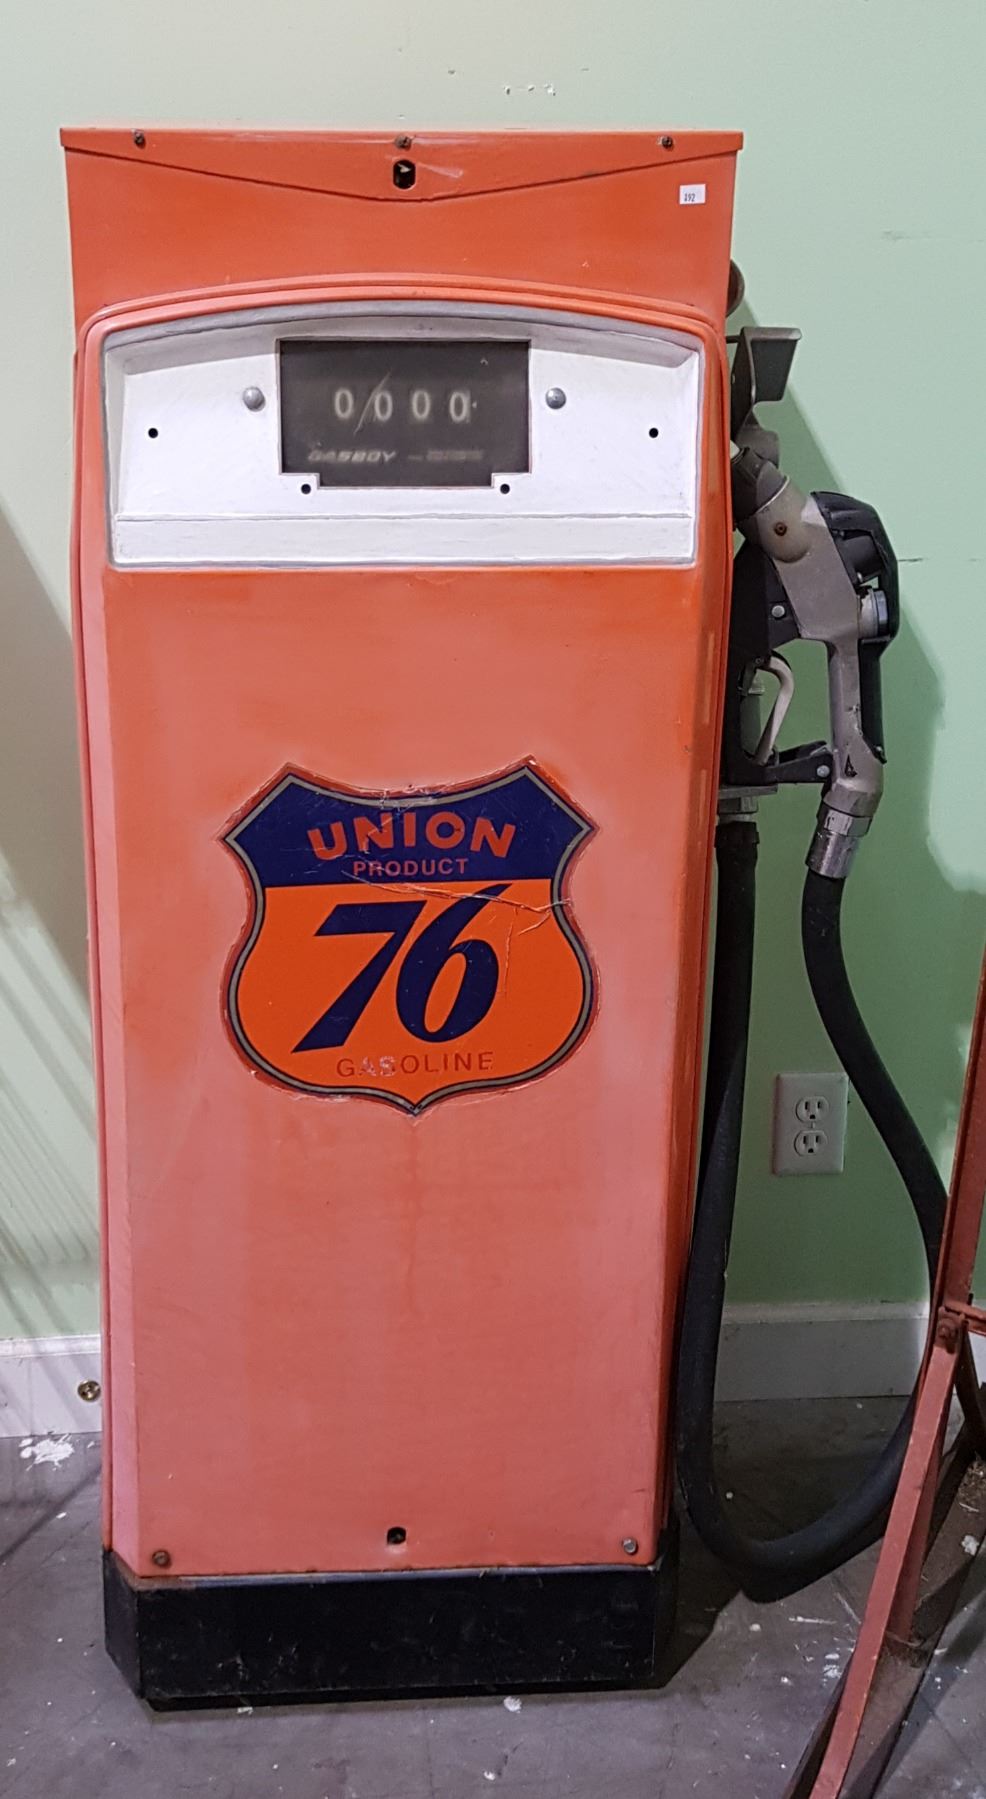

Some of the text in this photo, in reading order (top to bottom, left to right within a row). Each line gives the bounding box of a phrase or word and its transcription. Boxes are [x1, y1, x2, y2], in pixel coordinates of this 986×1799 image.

[307, 811, 516, 861] UNION
[353, 858, 469, 877] PRODUCT
[290, 883, 513, 1054] 76
[336, 1051, 494, 1078] GASOLINE
